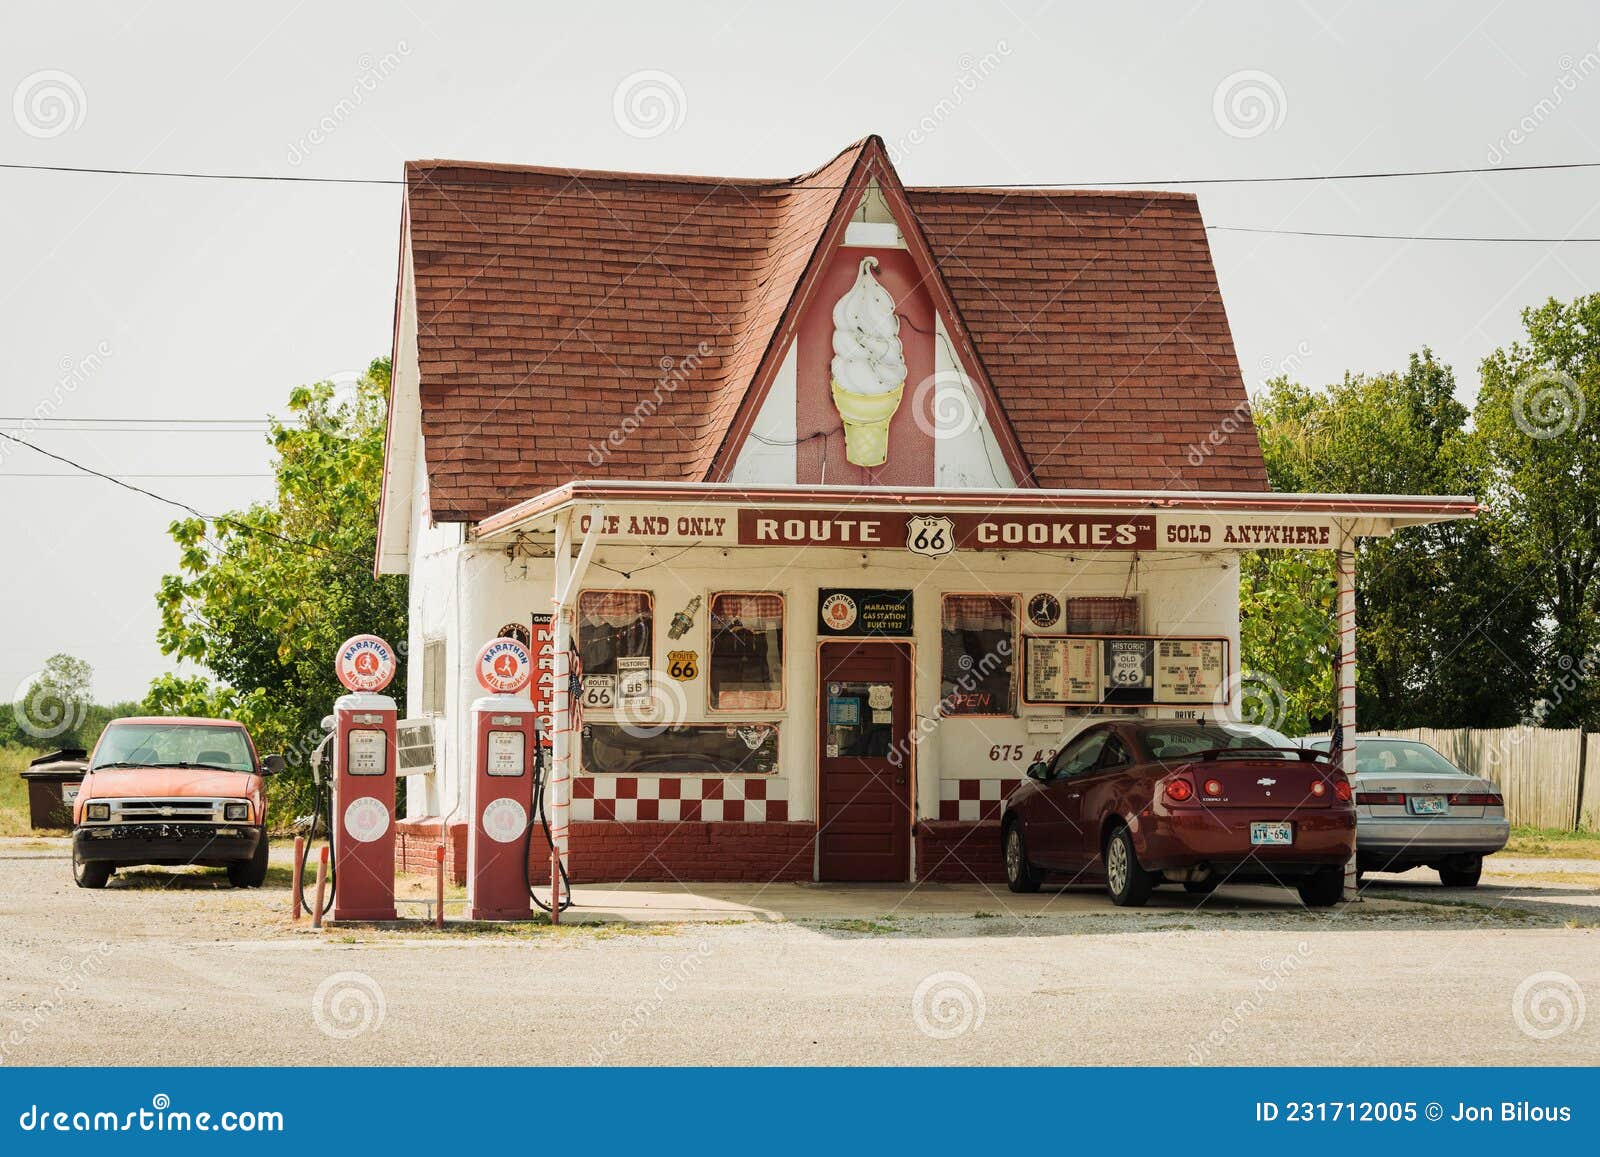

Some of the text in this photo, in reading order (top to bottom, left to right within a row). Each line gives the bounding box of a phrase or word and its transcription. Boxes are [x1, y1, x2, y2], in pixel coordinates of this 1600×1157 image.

[580, 514, 727, 537] OE AND ONLY
[756, 518, 881, 542] ROUTE
[923, 519, 938, 527] US
[914, 527, 944, 549] 66
[1166, 524, 1330, 545] SOLD ANYWHERE
[824, 595, 855, 609] MARATHON
[344, 641, 390, 661] MARATHON
[484, 643, 528, 665] MARATHON
[1120, 655, 1136, 663] OLD
[619, 660, 648, 668] HISTORIC
[671, 661, 695, 678] 66
[1118, 670, 1138, 682] 66
[587, 688, 610, 704] 66
[1174, 711, 1196, 719] DRIVE
[989, 744, 1023, 761] 675
